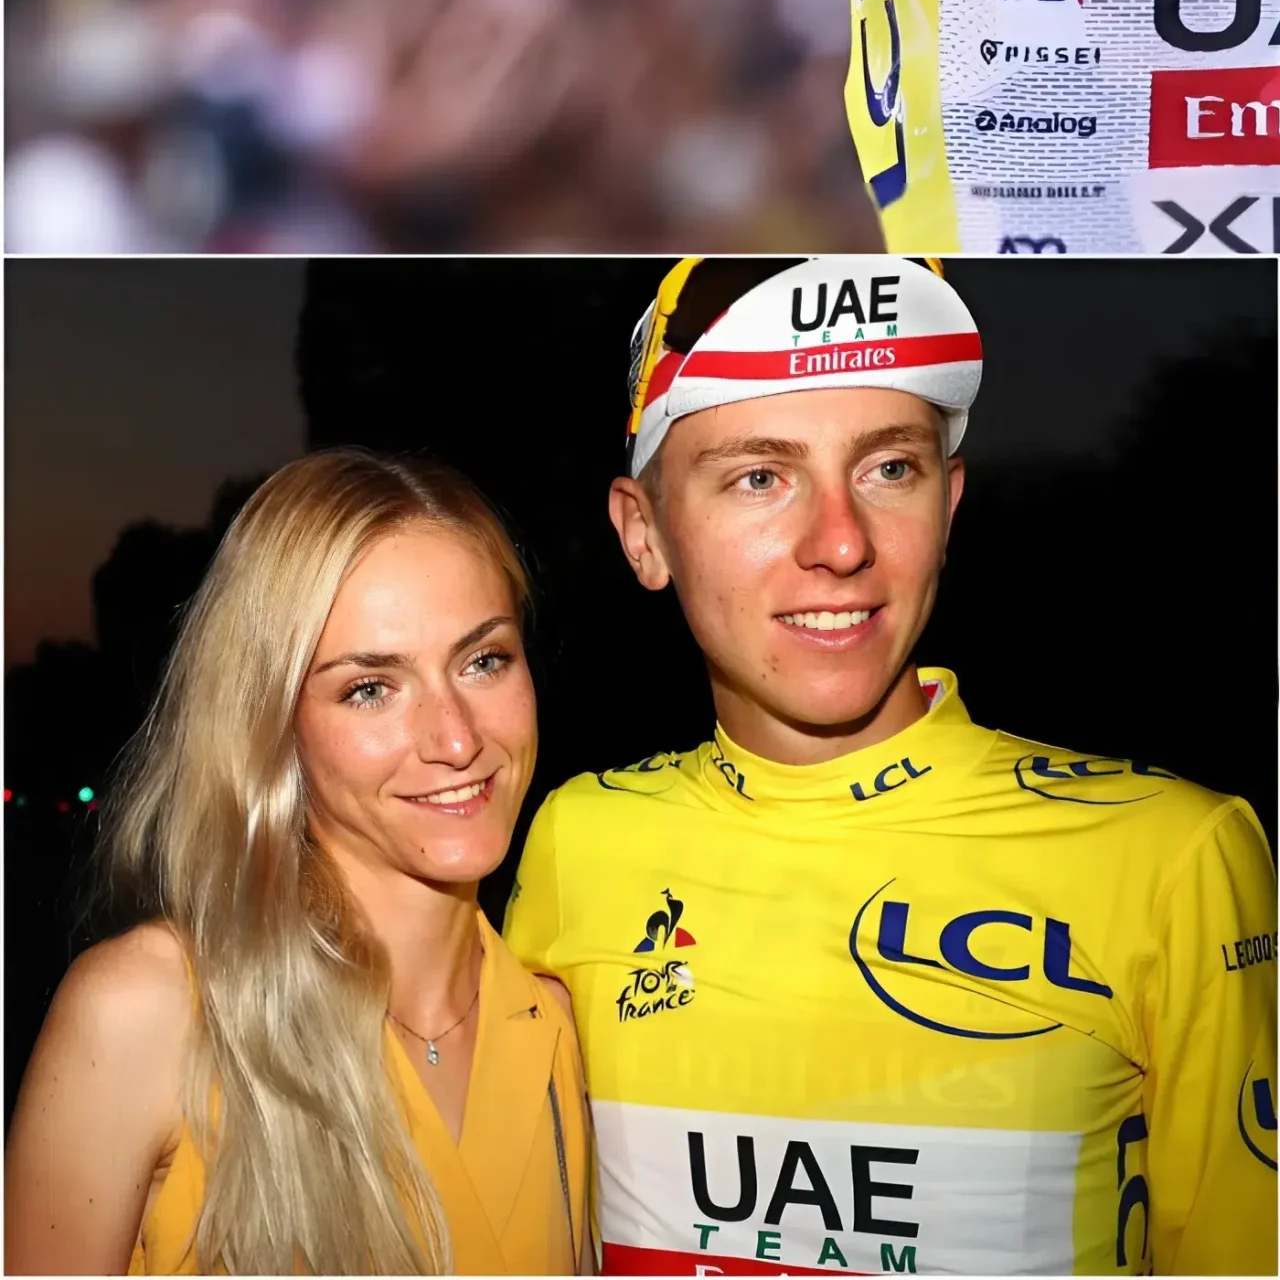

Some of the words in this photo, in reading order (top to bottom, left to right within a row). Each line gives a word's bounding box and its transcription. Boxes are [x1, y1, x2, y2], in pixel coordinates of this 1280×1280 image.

[792, 276, 900, 332] UAE
[792, 324, 898, 346] TEAM
[789, 347, 896, 375] Emirates
[850, 757, 932, 802] LCL
[1032, 756, 1178, 780] LCL
[877, 900, 1113, 1000] LCL
[687, 1131, 920, 1239] UAE
[693, 1223, 917, 1274] TEAM
